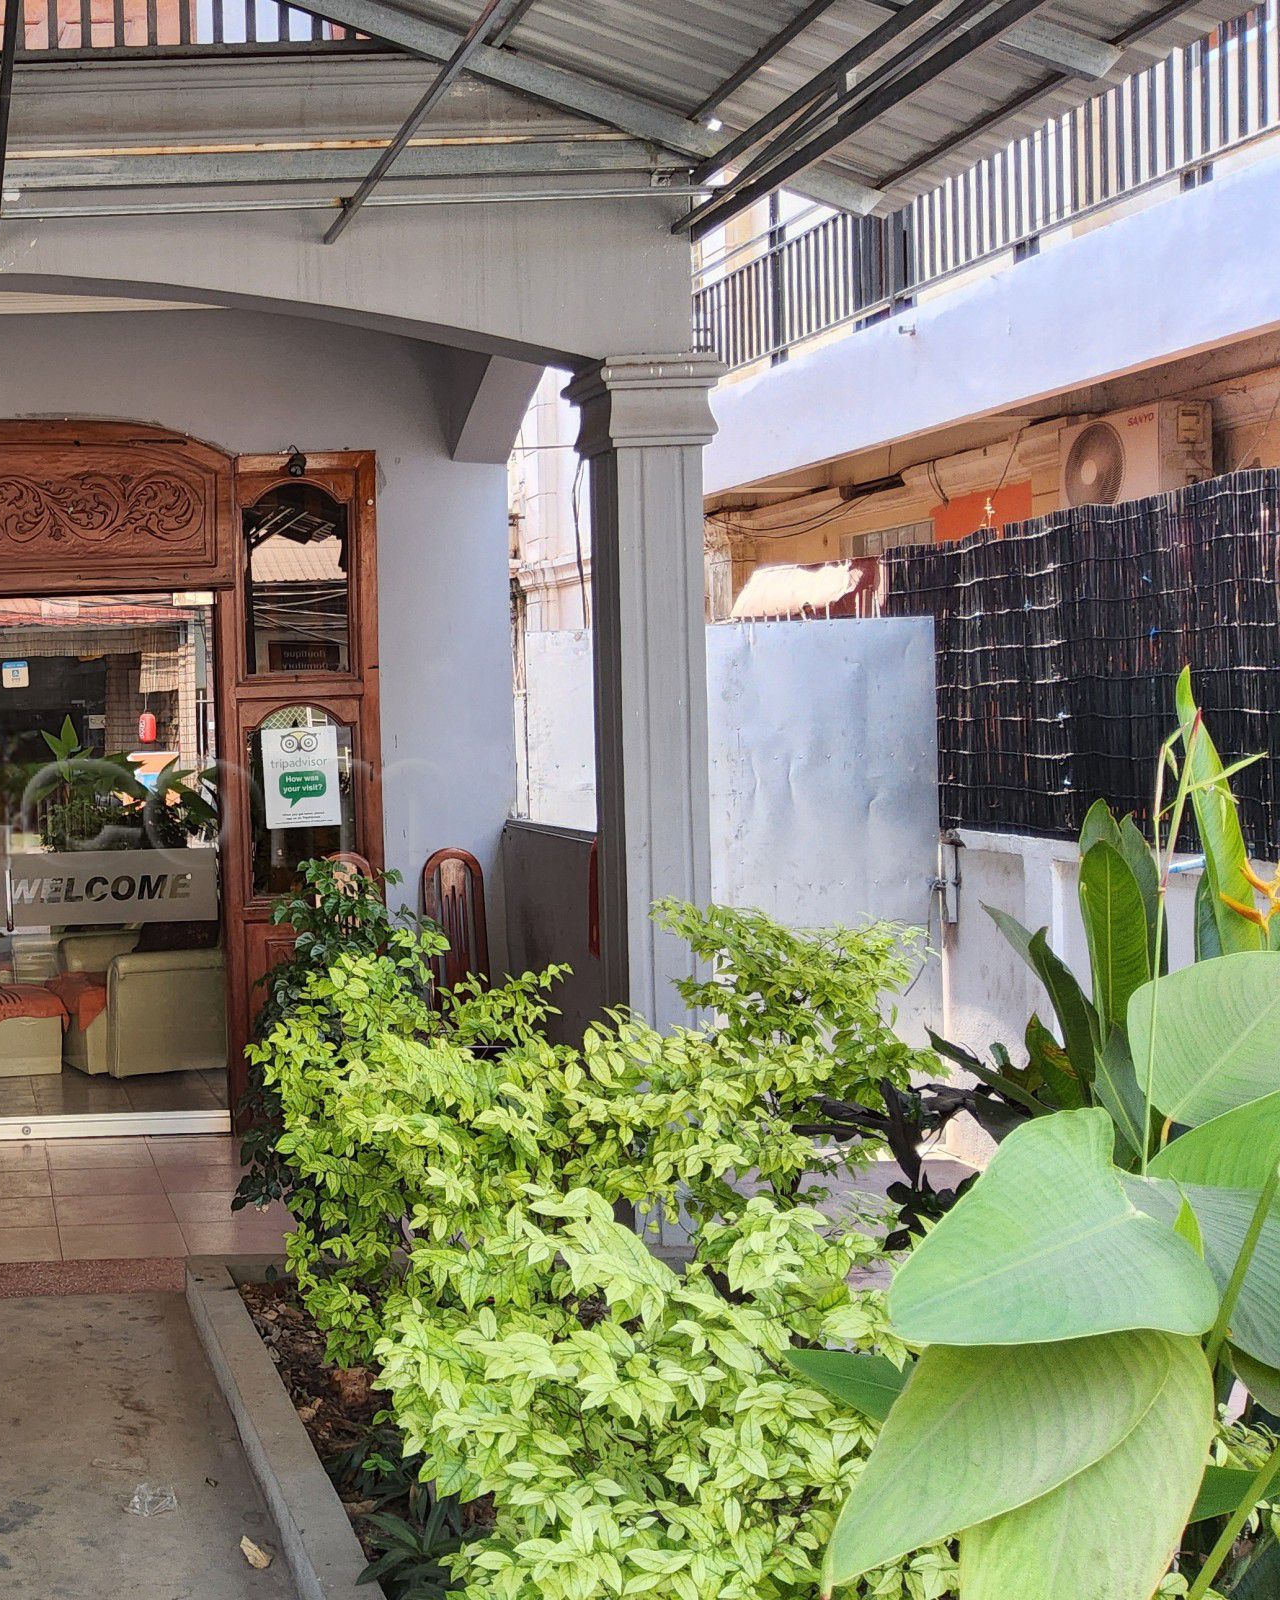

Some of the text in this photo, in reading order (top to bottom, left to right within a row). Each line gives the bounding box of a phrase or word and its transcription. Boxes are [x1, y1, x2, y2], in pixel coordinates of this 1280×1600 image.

[1127, 412, 1155, 427] SANYO
[270, 756, 327, 770] tripadvisor
[285, 775, 303, 783] How
[283, 783, 322, 794] your visit?
[11, 872, 192, 905] WELCOME
